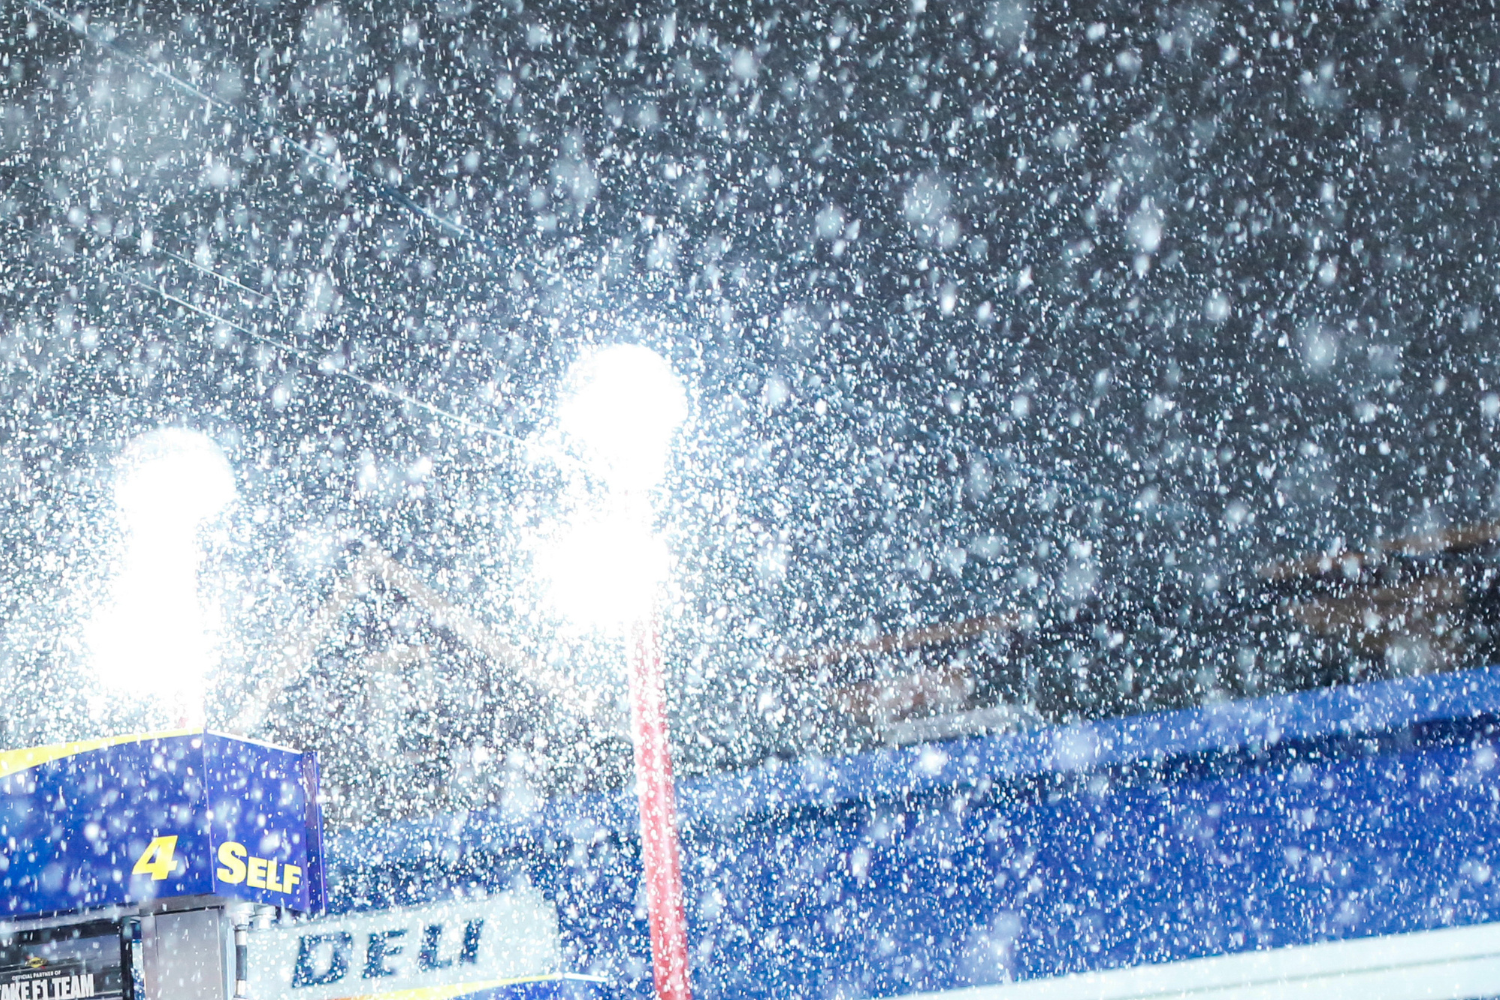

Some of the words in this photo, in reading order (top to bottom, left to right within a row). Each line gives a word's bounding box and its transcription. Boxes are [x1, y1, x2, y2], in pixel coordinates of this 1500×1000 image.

[131, 834, 178, 881] 4
[291, 917, 484, 989] DELI
[51, 974, 95, 1000] TEAM
